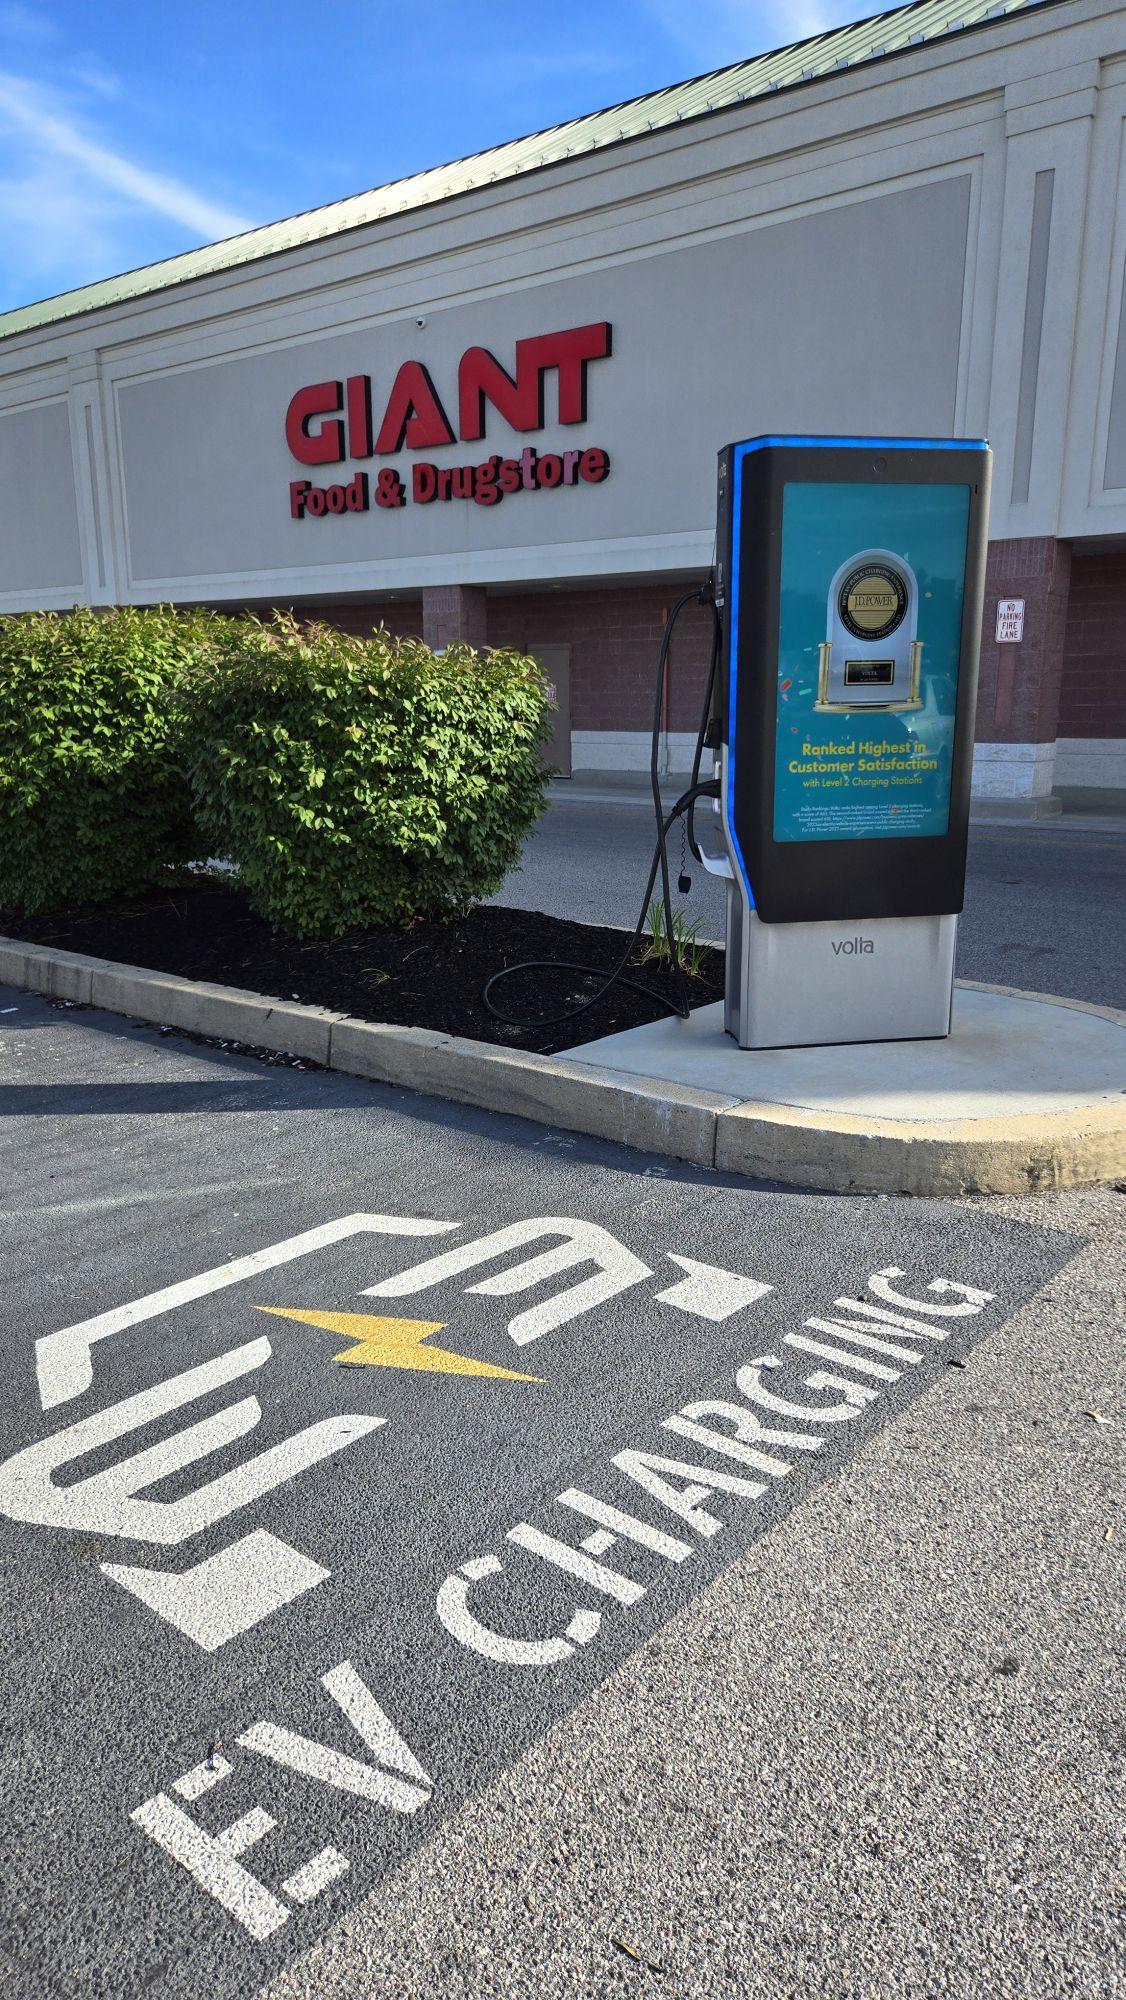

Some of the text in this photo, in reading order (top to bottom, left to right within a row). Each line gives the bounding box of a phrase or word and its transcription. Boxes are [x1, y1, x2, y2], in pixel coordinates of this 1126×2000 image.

[285, 321, 613, 465] GIANT
[290, 447, 611, 519] Food & Drugstore
[1006, 603, 1016, 612] NO
[1000, 612, 1022, 621] PARKING
[1002, 621, 1018, 630] FIRE
[1000, 631, 1018, 639] LANE
[802, 740, 927, 757] Ranked Highest in
[788, 758, 938, 773] Customer Satisfaction
[803, 775, 923, 788] with Level 2 Charging Stations
[831, 936, 874, 955] volta
[128, 1266, 998, 1942] EV CHARGING
